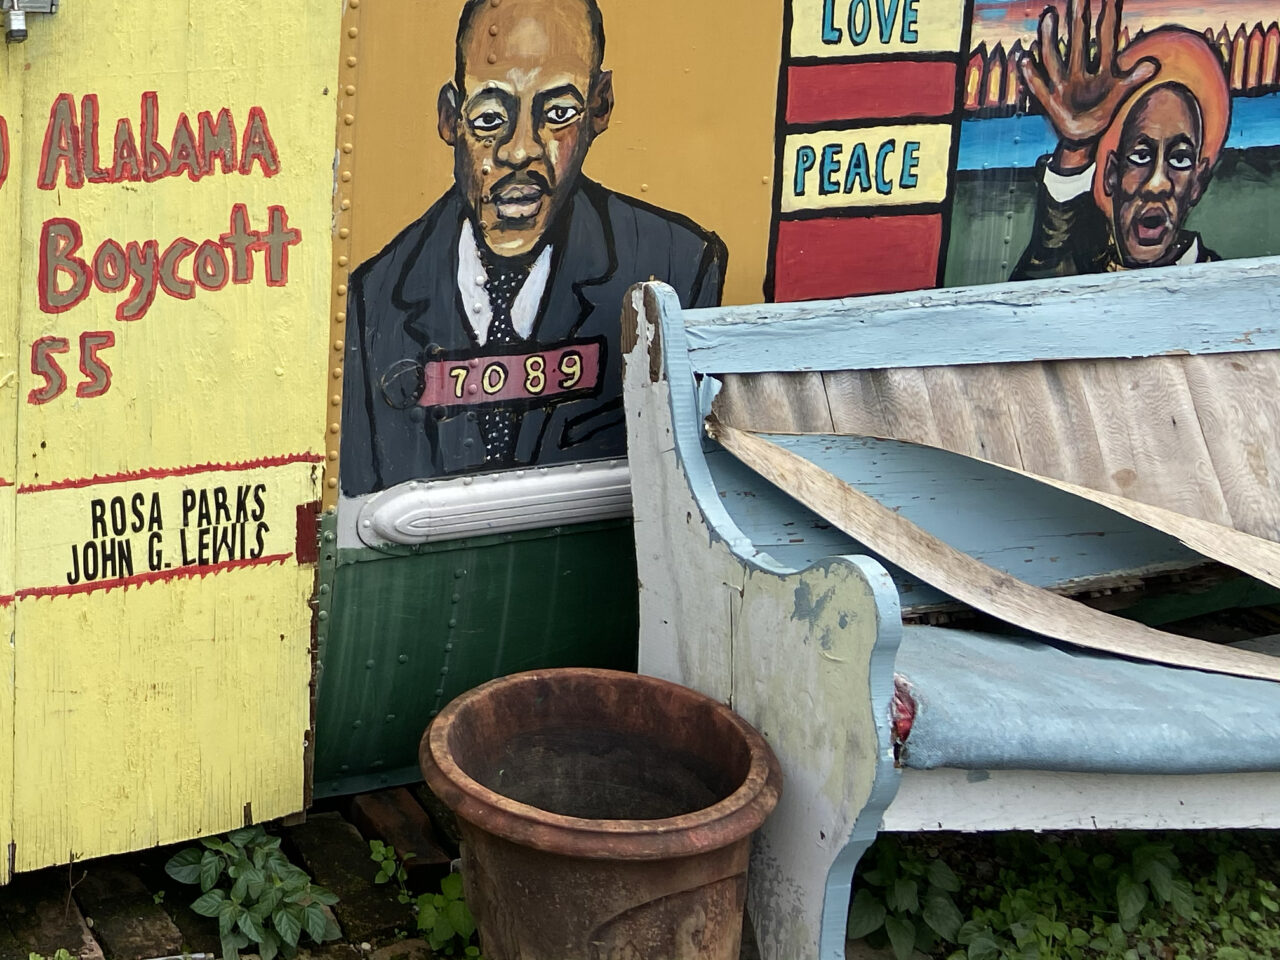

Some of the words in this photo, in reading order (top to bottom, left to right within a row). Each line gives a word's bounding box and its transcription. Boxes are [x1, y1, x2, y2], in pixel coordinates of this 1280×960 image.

[793, 140, 921, 196] PEACE
[92, 493, 163, 538] ROSA
[183, 484, 266, 528] PARKS
[67, 537, 134, 585] JOHN
[149, 531, 171, 571] G.
[180, 521, 269, 567] LEWIS
